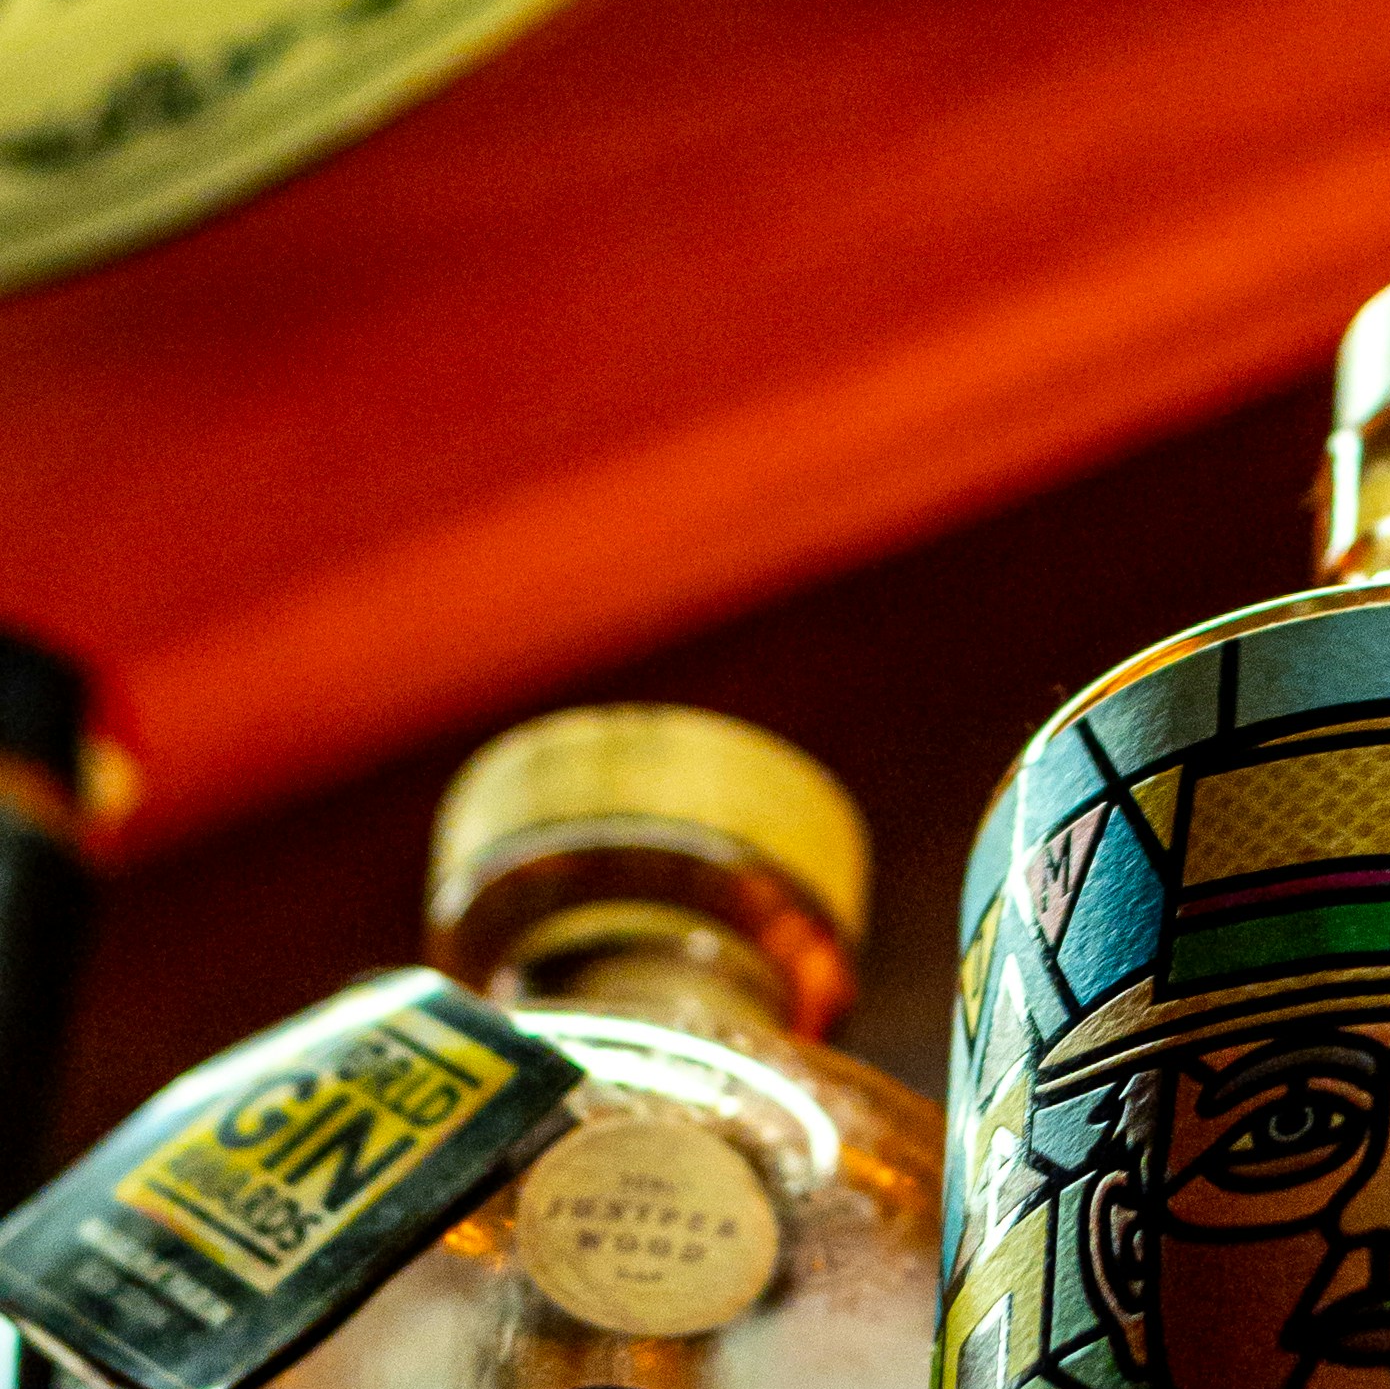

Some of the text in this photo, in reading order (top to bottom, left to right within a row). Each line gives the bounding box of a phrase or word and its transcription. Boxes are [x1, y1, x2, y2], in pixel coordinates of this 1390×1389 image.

[334, 1034, 464, 1129] RLD
[215, 1070, 417, 1212] GIN
[163, 1143, 322, 1251] ARDS
